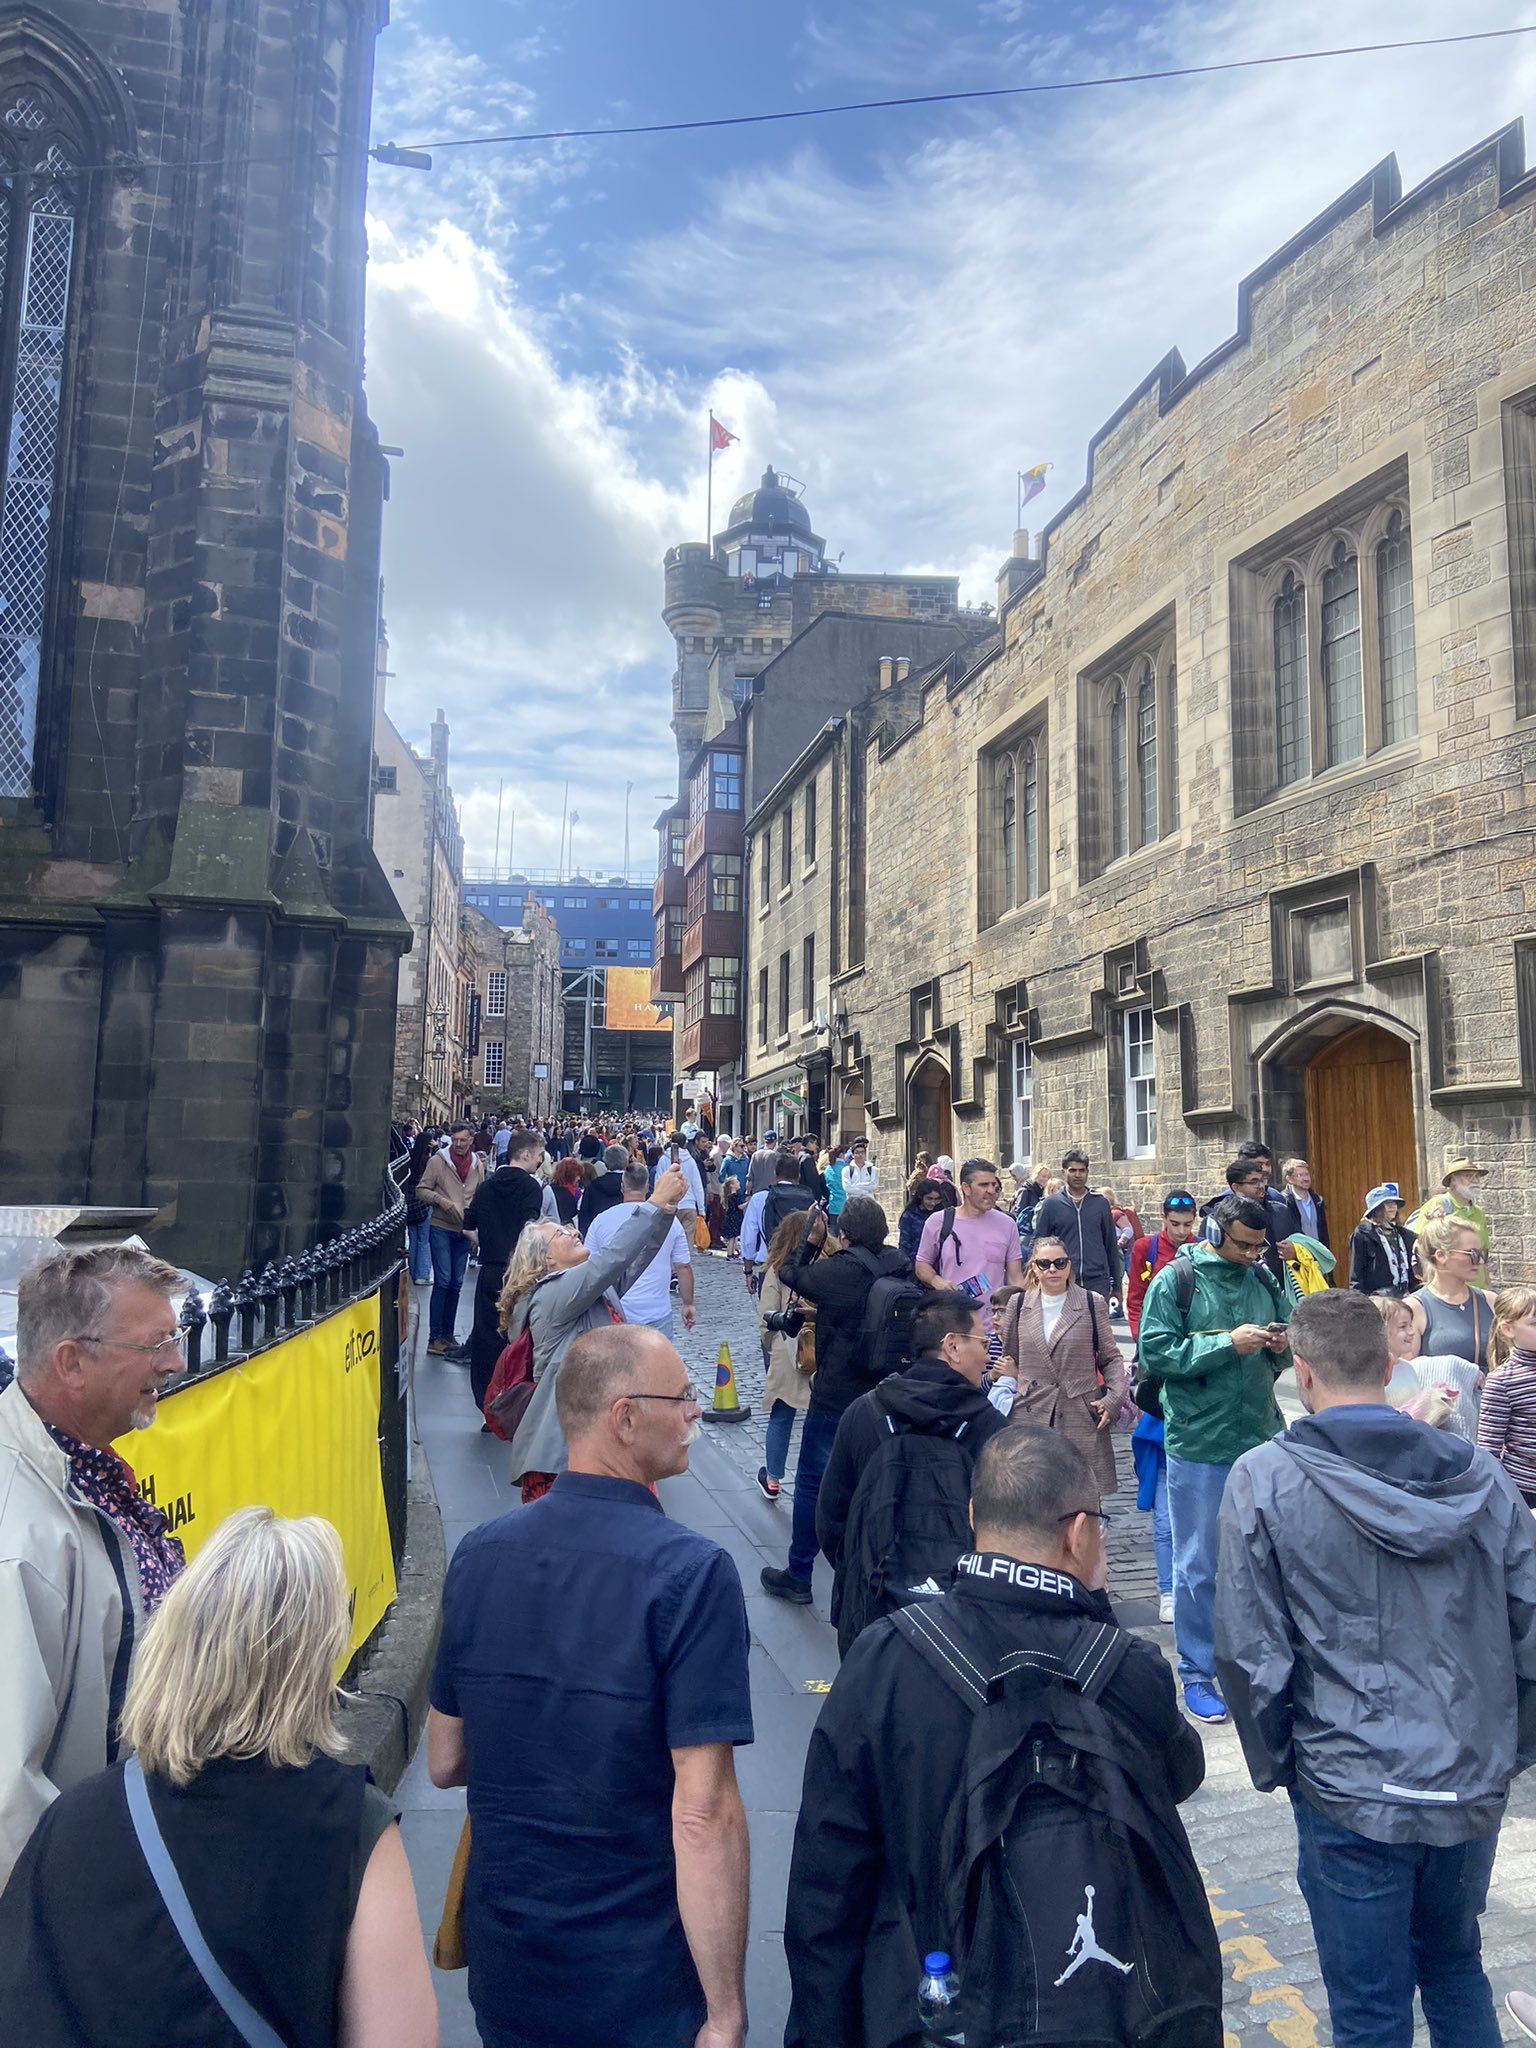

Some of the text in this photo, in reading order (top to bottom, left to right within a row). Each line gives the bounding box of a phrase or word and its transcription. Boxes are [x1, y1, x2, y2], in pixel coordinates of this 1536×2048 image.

[634, 1003, 674, 1012] HAMI
[753, 1073, 804, 1099] CASTLE GIFT SHOP
[957, 1554, 1074, 1599] HILFIGER
